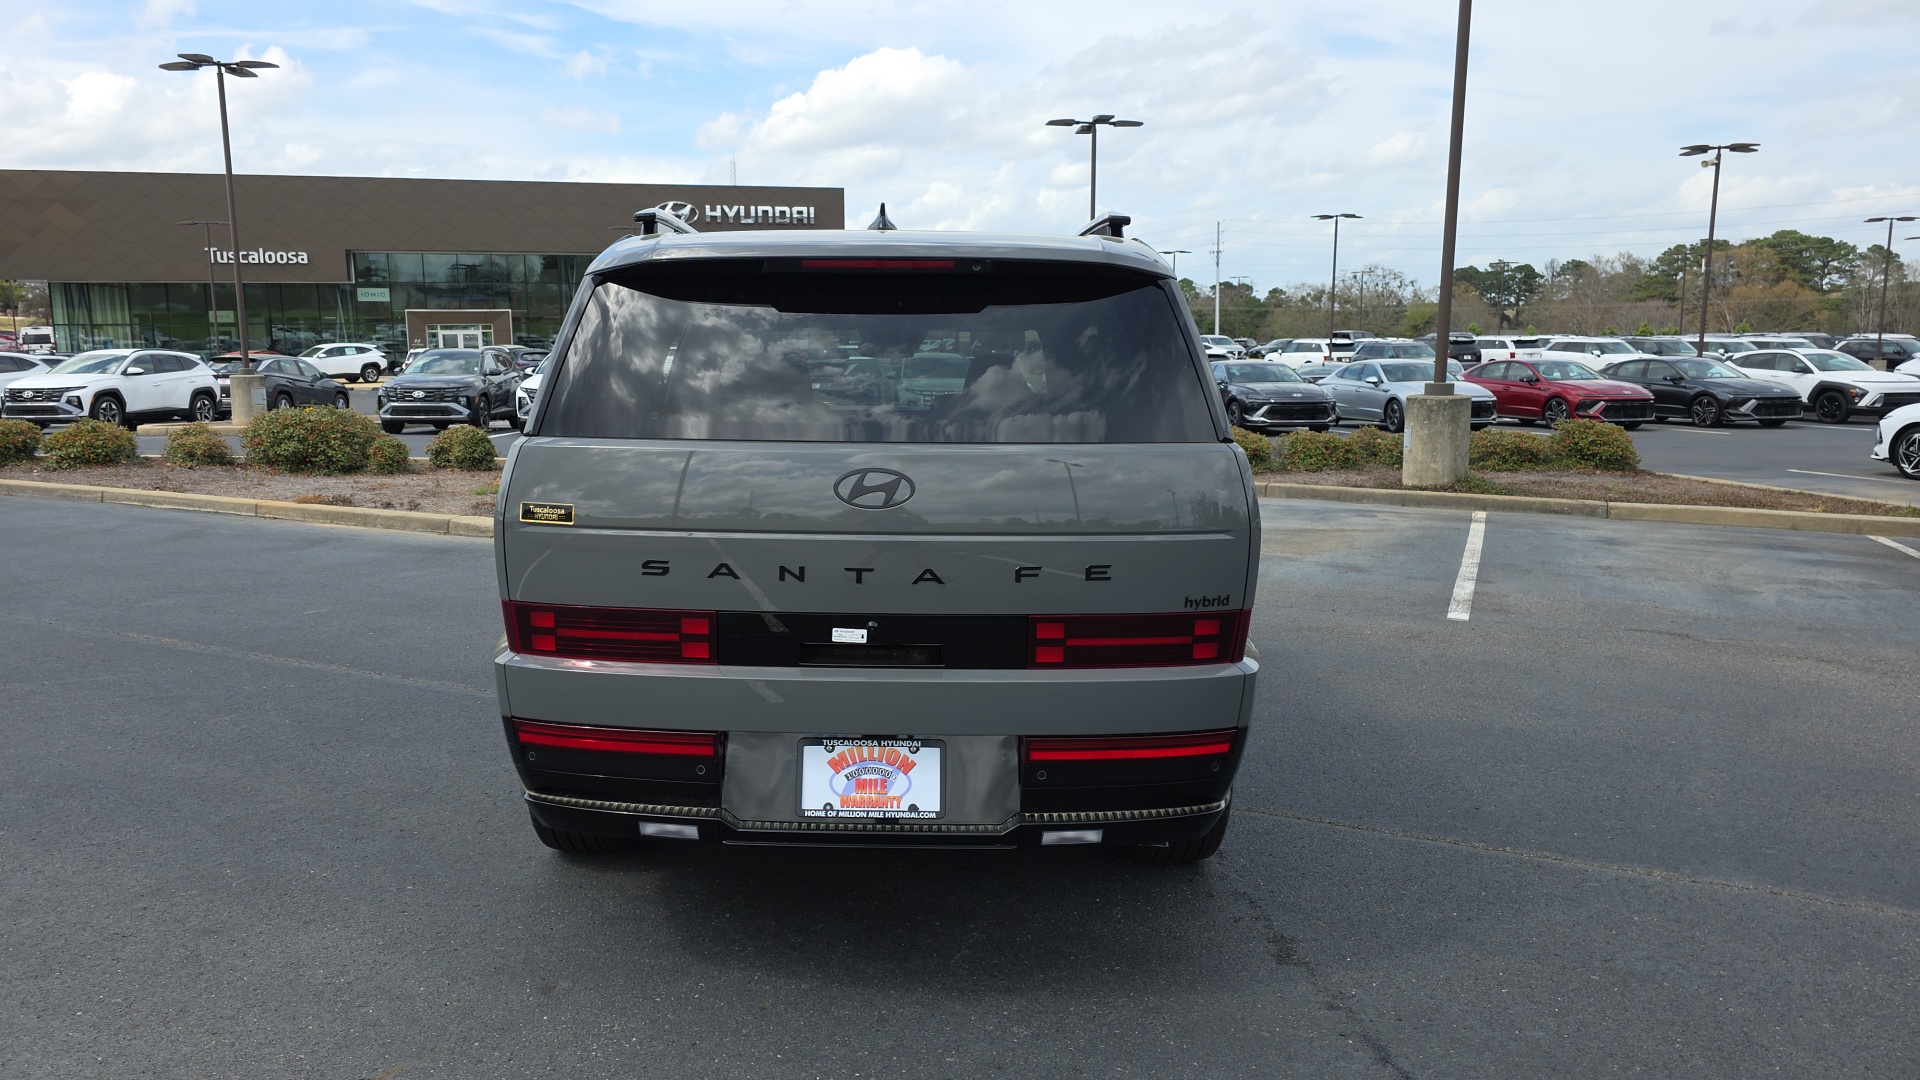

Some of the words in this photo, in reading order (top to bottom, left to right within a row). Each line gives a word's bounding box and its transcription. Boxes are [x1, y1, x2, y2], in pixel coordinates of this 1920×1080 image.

[705, 204, 815, 225] HYUNDAI
[203, 247, 309, 264] Tuscaloosa
[529, 505, 565, 515] Tuscaloosa
[641, 559, 946, 585] SANTA
[1014, 564, 1113, 583] FE
[1184, 594, 1231, 611] hybrid
[822, 739, 879, 747] TUSCALOOSA
[881, 740, 922, 748] HYUNDAI
[827, 746, 917, 776] MILLION
[855, 778, 889, 795] MILE
[839, 795, 903, 809] WARRANTY
[804, 810, 826, 818] HOME
[838, 811, 868, 819] MILLION
[868, 811, 884, 819] MILE
